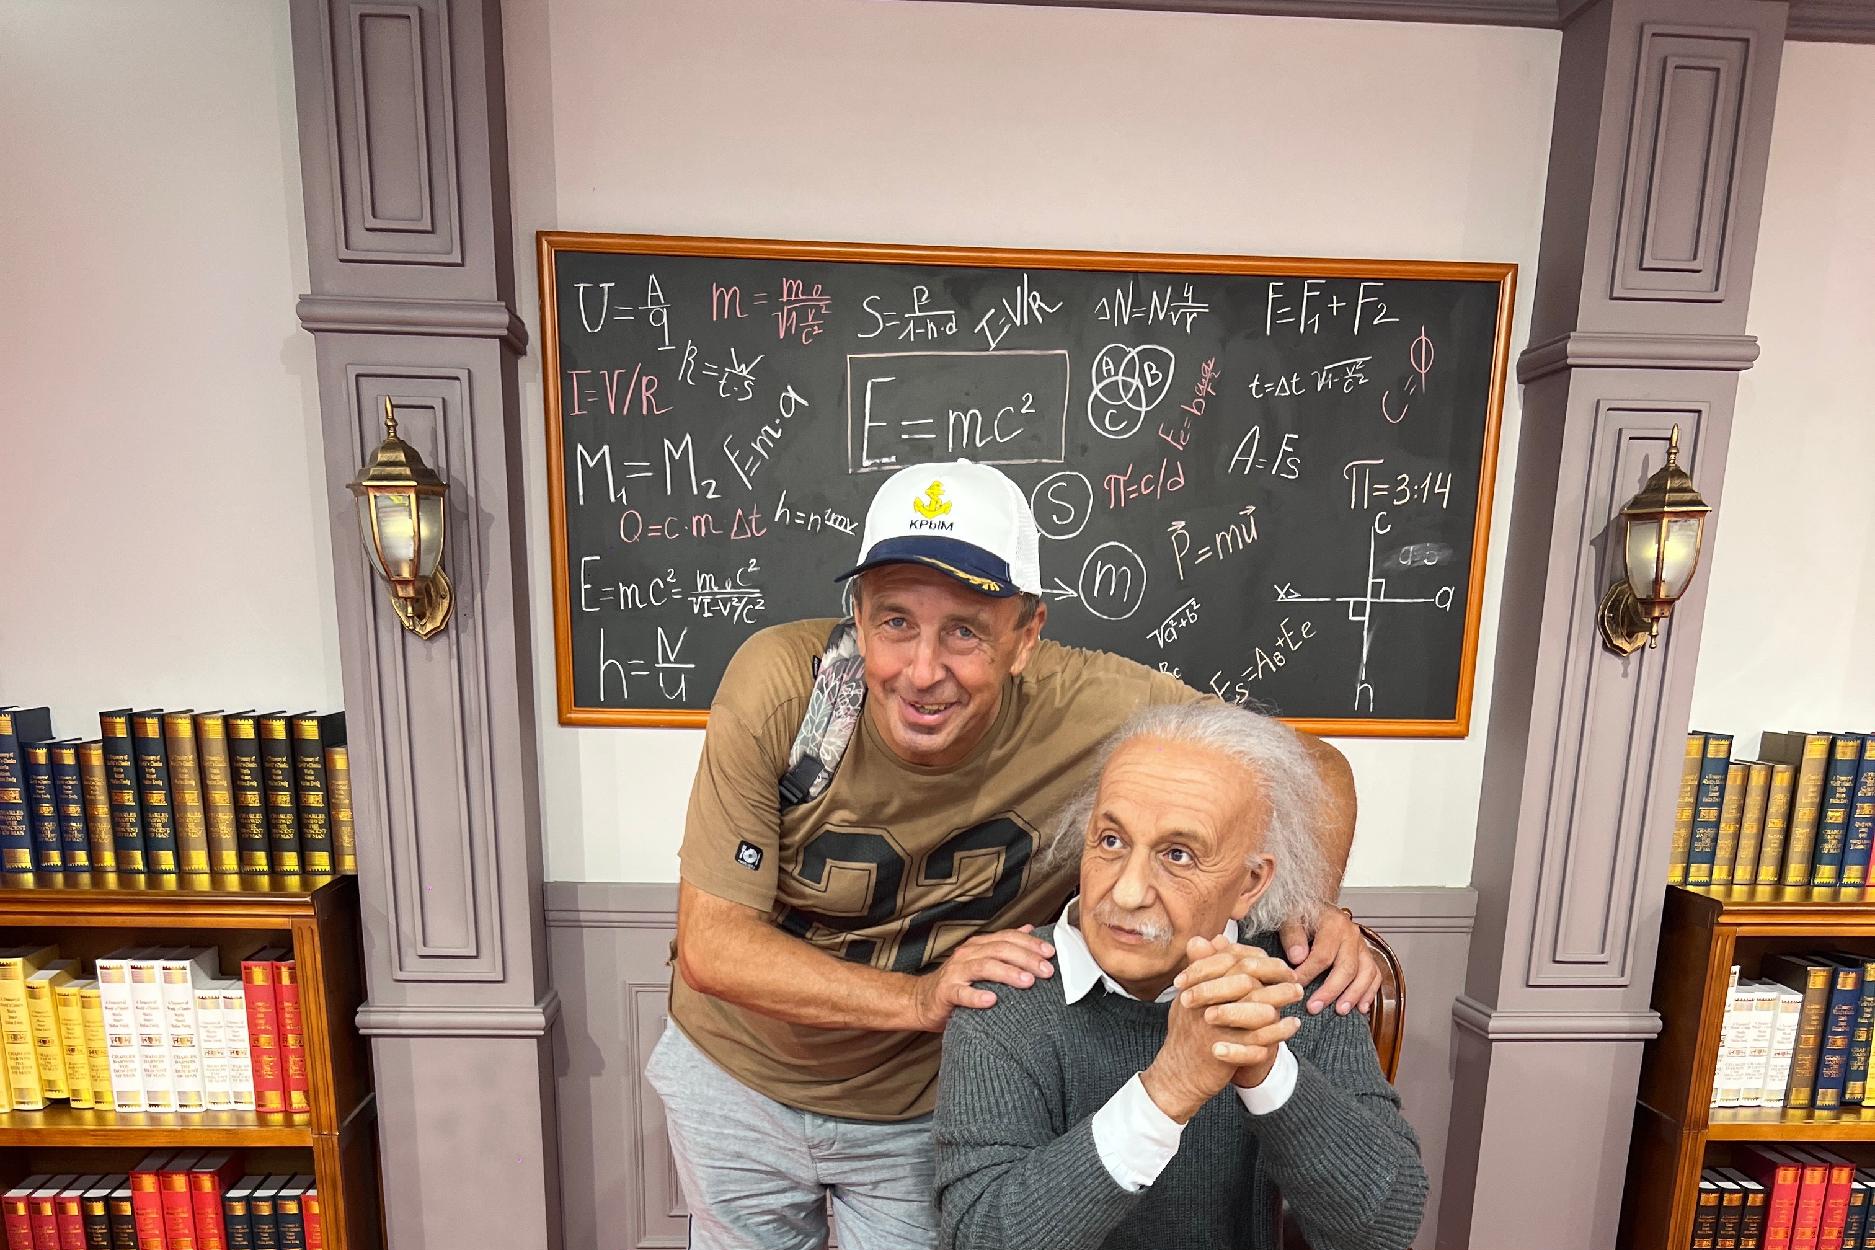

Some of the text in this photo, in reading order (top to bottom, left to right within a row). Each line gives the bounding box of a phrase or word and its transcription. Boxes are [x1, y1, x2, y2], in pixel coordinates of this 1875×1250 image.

[1101, 356, 1115, 379] A
[1143, 361, 1163, 387] B
[1104, 408, 1127, 431] C
[1046, 483, 1076, 526] S
[909, 518, 955, 532] КРЫМ
[1093, 559, 1132, 604] m
